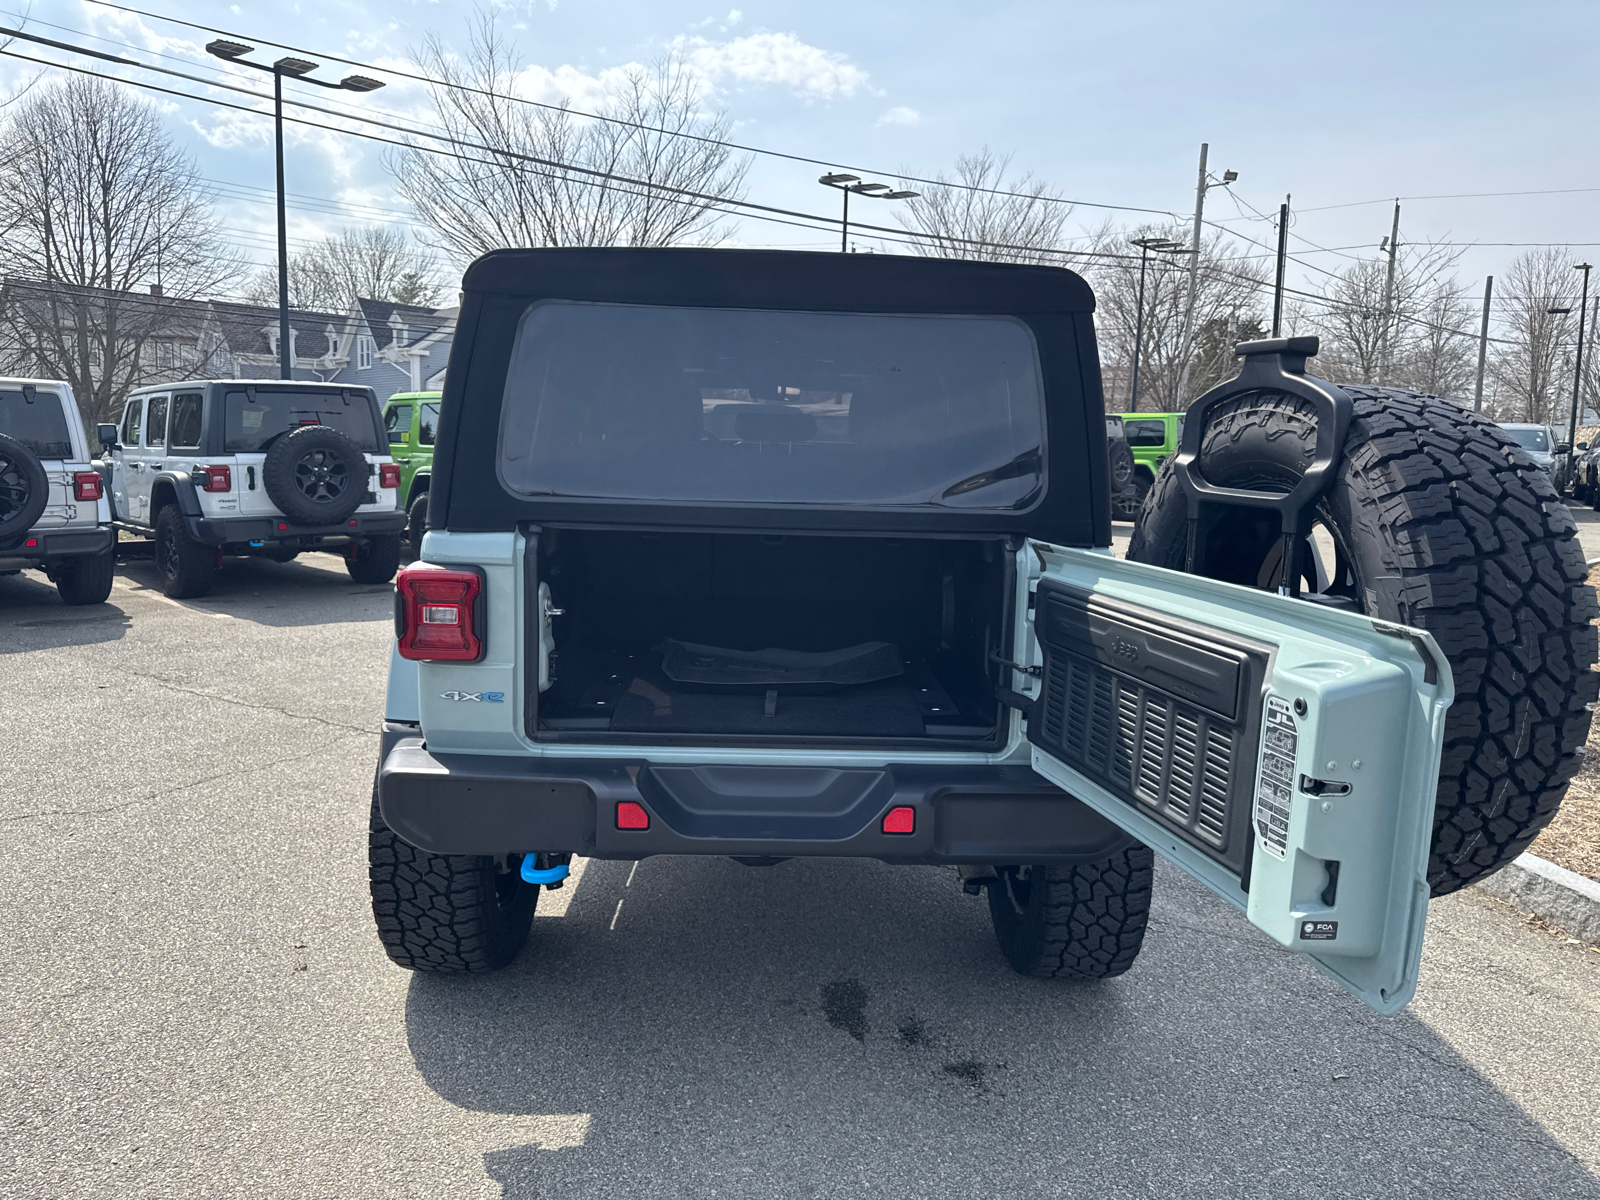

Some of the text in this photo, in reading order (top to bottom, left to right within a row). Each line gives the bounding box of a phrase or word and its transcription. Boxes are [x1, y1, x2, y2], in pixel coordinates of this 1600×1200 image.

[1111, 636, 1138, 662] Jeep
[1268, 712, 1294, 727] JL
[1271, 816, 1287, 831] USA
[1316, 923, 1334, 931] FCA
